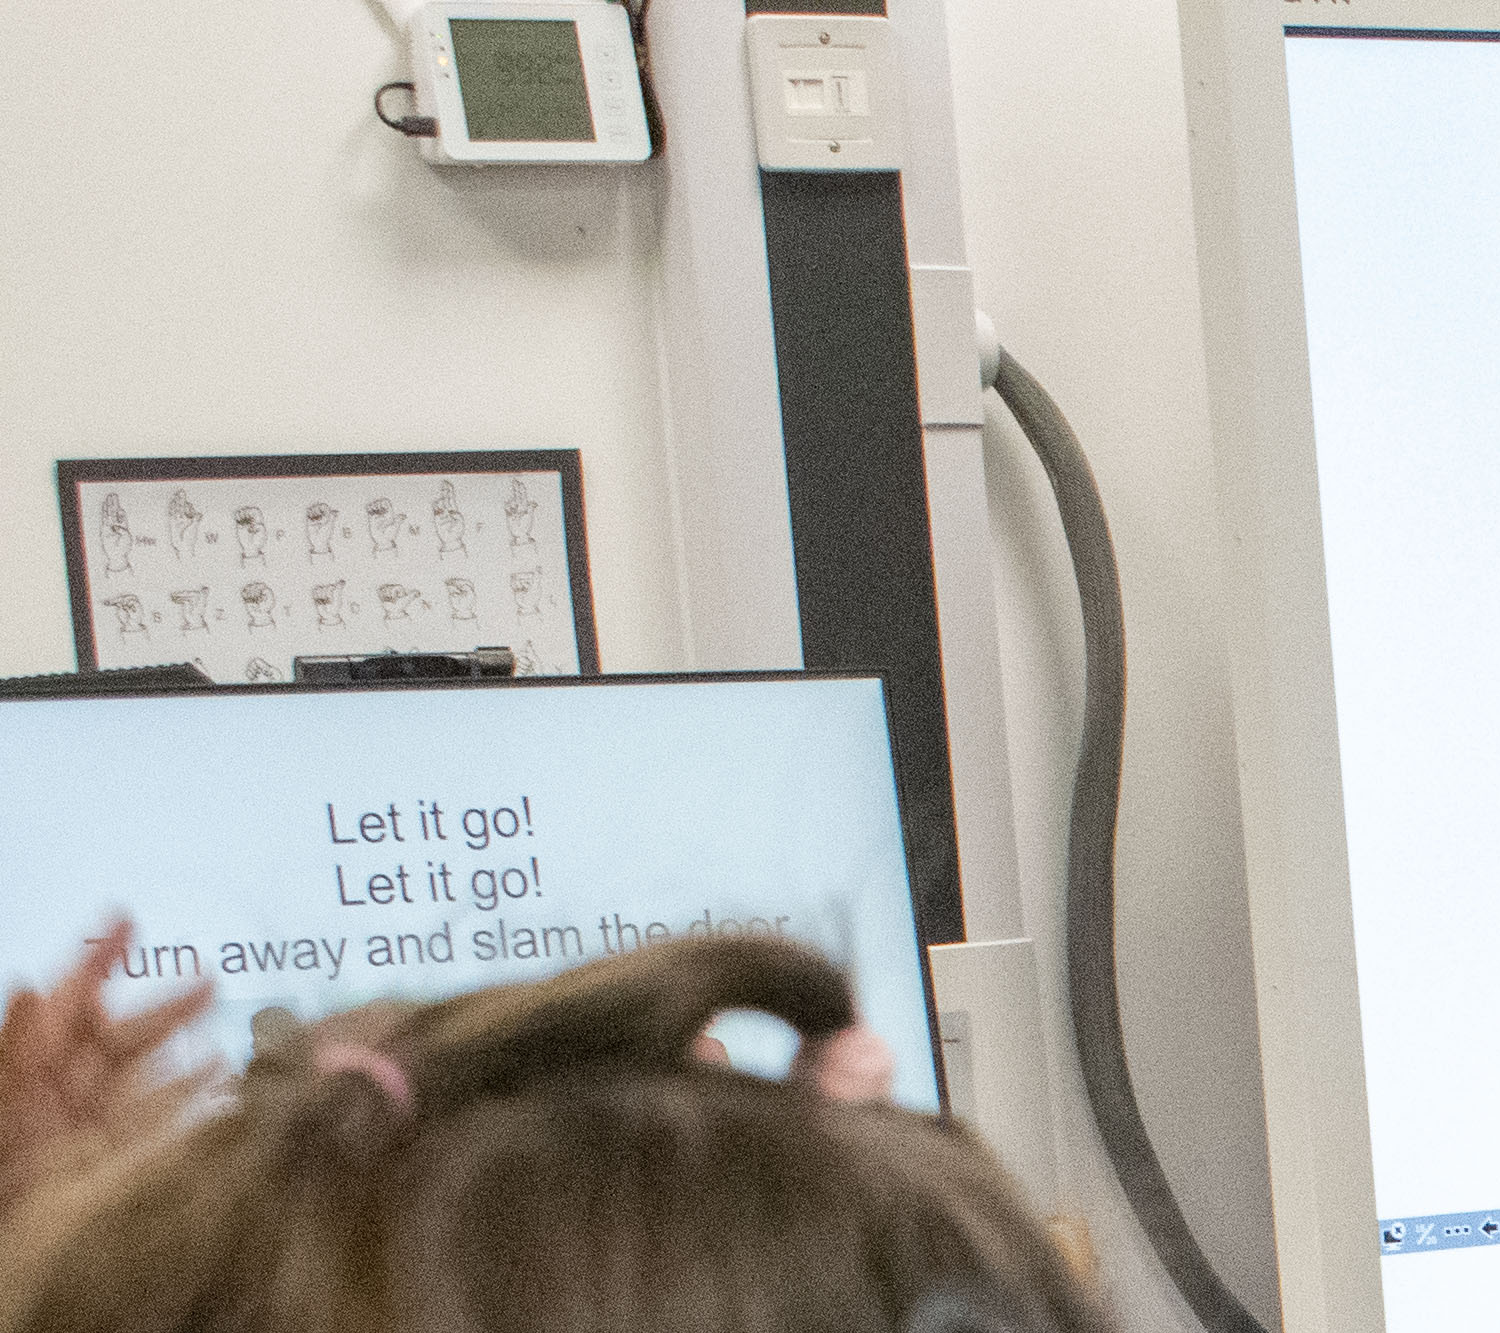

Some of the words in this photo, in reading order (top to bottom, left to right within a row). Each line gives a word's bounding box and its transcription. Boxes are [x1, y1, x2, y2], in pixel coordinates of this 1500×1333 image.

[327, 801, 405, 845] Let
[417, 799, 448, 842] it
[462, 795, 535, 851] go!
[335, 863, 414, 906] Let
[427, 860, 457, 902] it
[471, 855, 542, 912] go!
[220, 936, 347, 981] away
[366, 921, 454, 967] and
[472, 917, 584, 961] slam
